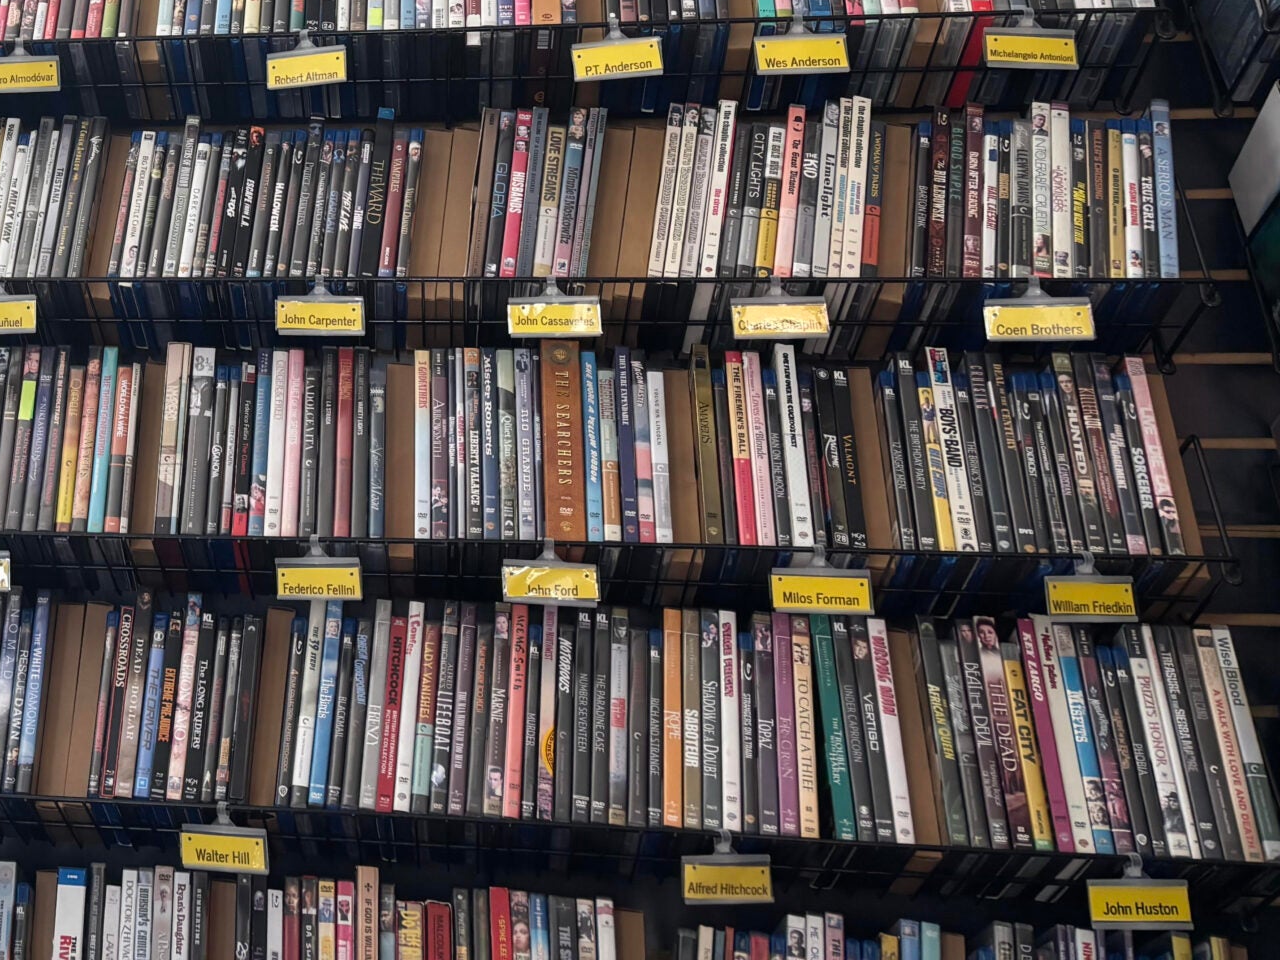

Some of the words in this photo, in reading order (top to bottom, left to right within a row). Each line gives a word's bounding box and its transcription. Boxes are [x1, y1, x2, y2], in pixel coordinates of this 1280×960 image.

[764, 58, 788, 69] Wes
[790, 56, 841, 68] Anderson
[990, 48, 1038, 60] Michelangelo
[1040, 52, 1074, 63] Antonioni
[585, 64, 602, 76] P.T.
[604, 60, 653, 74] Anderson
[10, 72, 54, 84] Almodóvar
[274, 71, 306, 85] Robert
[307, 70, 338, 83] Altman
[282, 313, 306, 326] John
[308, 316, 356, 329] Carpenter
[515, 315, 538, 327] John
[996, 324, 1027, 336] Coen
[1032, 323, 1083, 336] Brothers
[554, 371, 568, 398] THE
[556, 402, 572, 486] SEARCHERS
[1132, 447, 1154, 510] SORCERER
[282, 583, 324, 596] Federico
[326, 584, 356, 596] Fellini
[525, 584, 552, 596] John
[554, 584, 579, 596] Ford
[782, 591, 813, 603] Milos
[816, 593, 860, 606] Forman
[1052, 599, 1092, 612] William
[1092, 601, 1132, 614] Friedkin
[115, 613, 131, 687] CROSSROADS
[387, 636, 402, 705] HITCHCOCK
[558, 637, 571, 693] NOTORIOUS
[1011, 688, 1027, 716] FAT
[863, 693, 879, 751] VERTIGO
[996, 719, 1017, 772] DEAD
[1016, 723, 1036, 764] CITY
[195, 848, 229, 864] Walter
[232, 851, 250, 866] Hill
[687, 882, 718, 894] Alfred
[720, 882, 769, 896] Hitchcock
[1103, 902, 1134, 916] John
[1135, 902, 1179, 916] Huston
